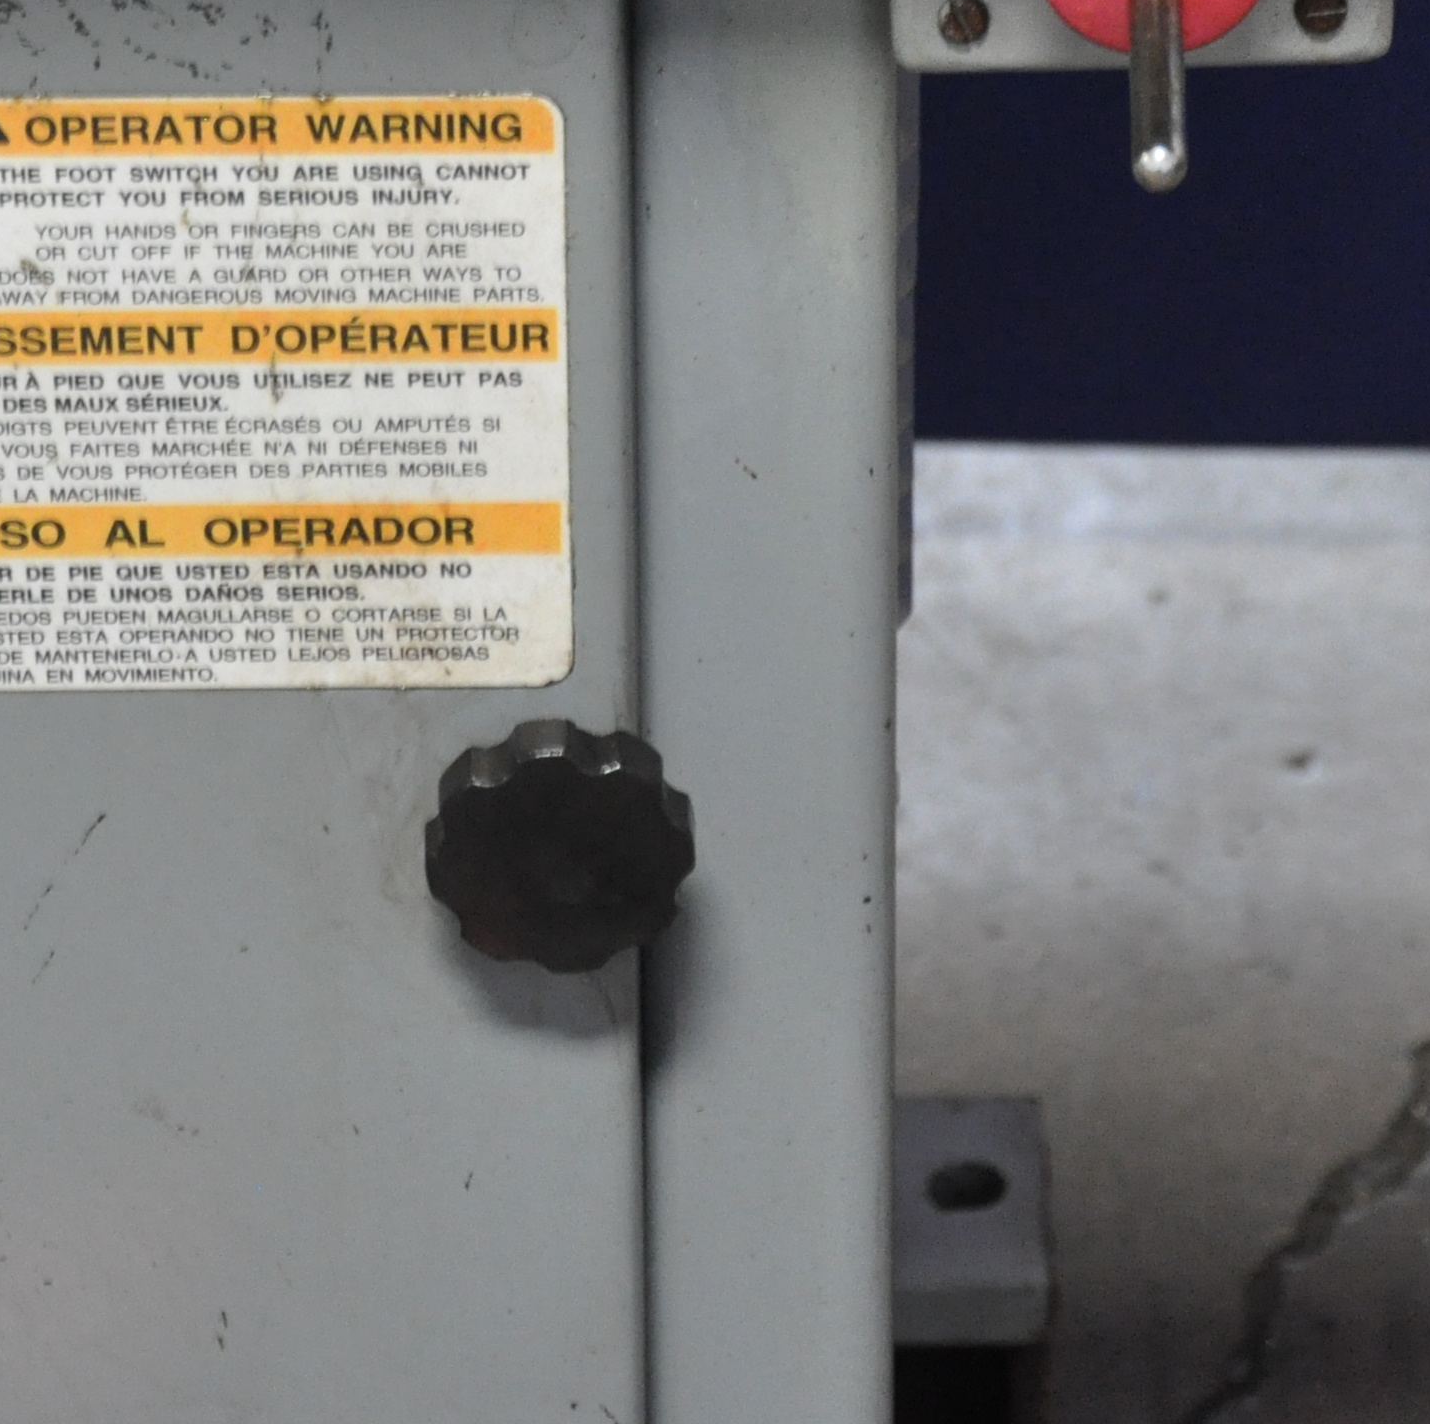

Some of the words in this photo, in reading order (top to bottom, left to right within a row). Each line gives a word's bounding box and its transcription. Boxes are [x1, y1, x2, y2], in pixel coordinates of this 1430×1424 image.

[25, 114, 276, 145] OPERATOR
[307, 112, 520, 143] WARNING
[54, 166, 117, 182] FOOT
[128, 165, 219, 182] SWITCH
[230, 165, 280, 181] YOU
[291, 164, 339, 181] ARE
[351, 164, 425, 181] USING
[434, 163, 531, 180] CANNOT
[118, 189, 166, 206] YOU
[179, 189, 245, 206] FROM
[257, 188, 359, 205] SERIOUS
[371, 188, 459, 205] INJURY.
[38, 224, 92, 240] YOUR
[105, 223, 175, 239] HANDS
[187, 223, 218, 239] OR
[230, 222, 320, 238] FINGERS
[332, 222, 375, 238] CAN
[387, 222, 412, 237] BE
[425, 221, 525, 237] CRUSHED
[34, 245, 66, 260] OR
[77, 244, 118, 260] CUT
[130, 244, 171, 260] OFF
[183, 244, 201, 260] IF
[213, 244, 254, 259] THE
[264, 243, 358, 259] MACHINE
[371, 243, 415, 258] YOU
[425, 242, 467, 258] ARE
[66, 268, 110, 284] NOT
[120, 268, 176, 284] HAVE
[187, 268, 202, 283] A
[212, 267, 288, 283] GUARD
[297, 267, 329, 283] OR
[339, 266, 412, 282] OTHER
[421, 266, 483, 282] WAYS
[492, 265, 522, 281] TO
[57, 289, 119, 304] FROM
[131, 288, 262, 304] DANGEROUS
[274, 288, 356, 303] MOVING
[368, 287, 460, 303] MACHINE
[472, 287, 543, 302] PARTS.
[23, 369, 40, 390] À
[52, 374, 105, 390] PIED
[116, 373, 165, 390] QUE
[177, 373, 241, 389] VOUS
[252, 372, 352, 389] UTILISEZ
[363, 372, 394, 388] NE
[406, 371, 466, 387] PEUT
[477, 371, 523, 387] PAS
[1, 397, 48, 413] DES
[53, 397, 119, 413] MAUX
[124, 391, 228, 412] SÉRIEUX.
[63, 419, 160, 435] PEUVENT
[223, 413, 322, 434] ÉCRASÉS
[331, 418, 363, 433] OU
[372, 412, 472, 433] AMPUTÉS
[481, 417, 501, 432] SI
[0, 442, 59, 457] VOUS
[68, 442, 141, 457] FAITES
[150, 436, 253, 456] MARCHÉE
[263, 441, 297, 456] N'A
[306, 441, 328, 455] NI
[338, 435, 448, 455] DÉFENSES
[457, 440, 478, 454] NI
[15, 465, 45, 480] DE
[55, 464, 114, 480] VOUS
[123, 458, 238, 479] PROTÉGER
[248, 463, 291, 478] DES
[295, 462, 389, 478] PARTIES
[396, 461, 488, 477] MOBILES
[12, 488, 39, 503] LA
[48, 487, 147, 502] MACHINE.
[103, 519, 165, 547] AL
[202, 517, 475, 547] OPERADOR
[24, 565, 55, 581] DE
[67, 565, 103, 581] PIE
[114, 564, 163, 580] QUE
[174, 564, 251, 580] USTED
[260, 563, 321, 579] ESTA
[331, 562, 429, 579] USANDO
[438, 562, 473, 578] NO
[66, 587, 97, 603] DE
[109, 587, 173, 602] UNOS
[184, 581, 265, 602] DAÑOS
[275, 585, 365, 601] SERIOS.
[183, 647, 198, 662] A
[208, 647, 277, 662] USTED
[286, 646, 352, 661] LEJOS
[45, 668, 74, 683] EN
[83, 667, 218, 683] MOVIMIENTO.
